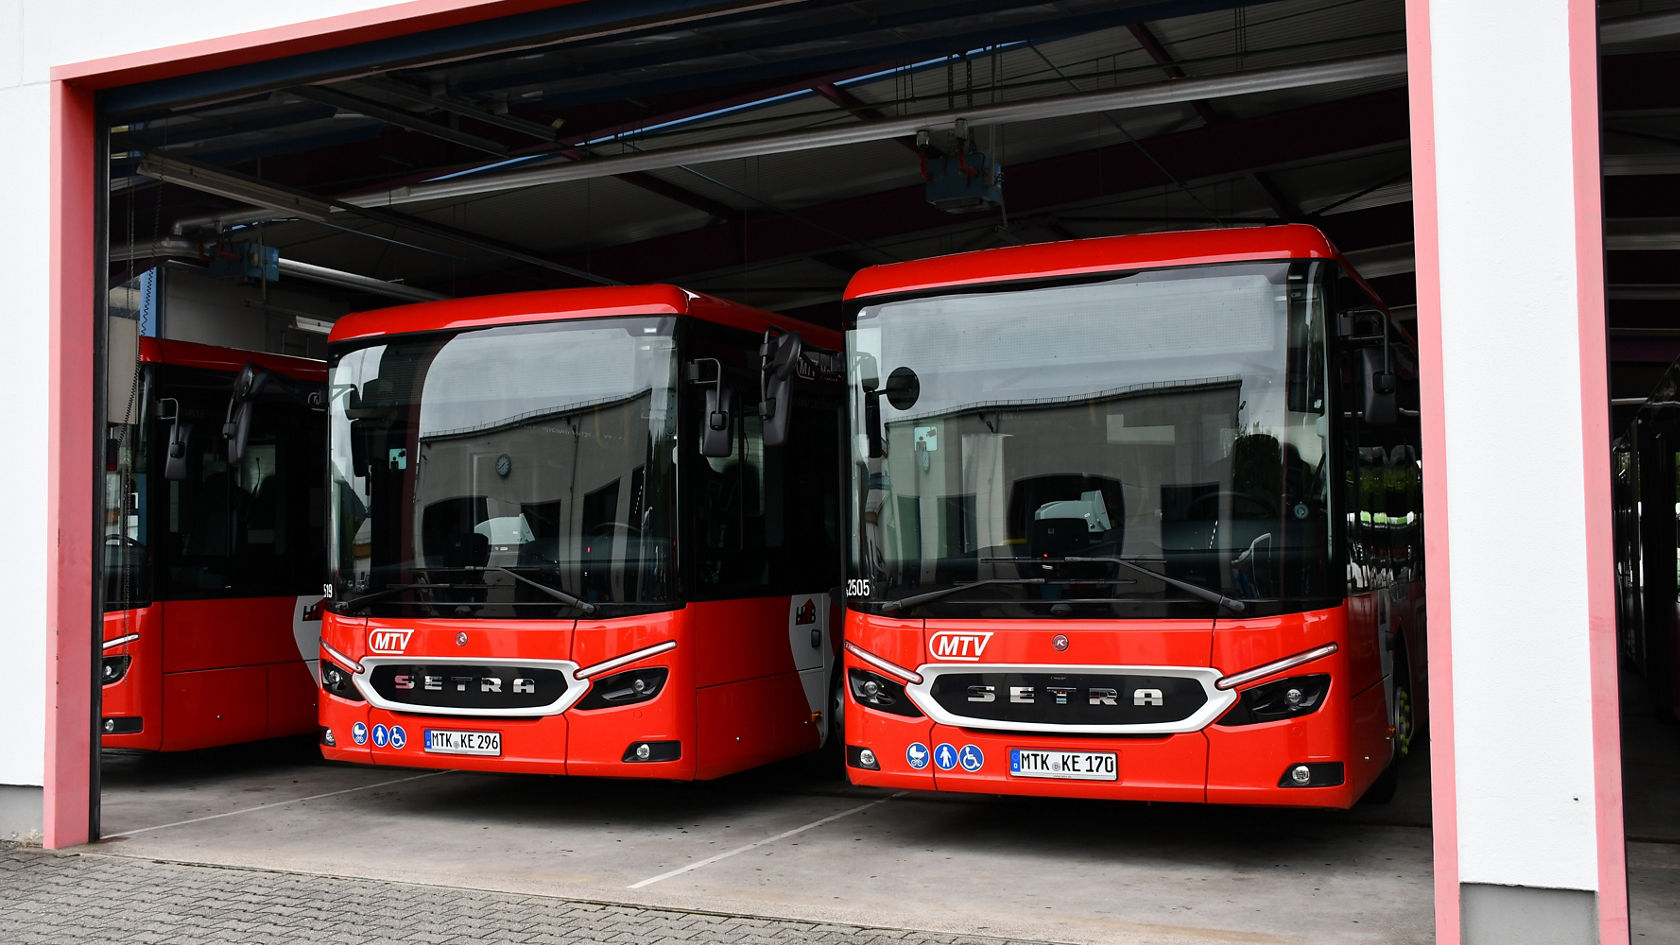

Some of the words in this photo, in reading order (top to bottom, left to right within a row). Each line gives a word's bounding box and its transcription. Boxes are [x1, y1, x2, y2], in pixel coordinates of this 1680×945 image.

[374, 630, 414, 650] MTV
[937, 633, 994, 656] MTV
[395, 675, 535, 694] SETRA
[967, 685, 1164, 706] SETRA
[432, 733, 453, 748] MTK
[460, 734, 475, 749] KE
[477, 735, 499, 750] 296
[1021, 753, 1050, 771] MTK
[1061, 755, 1081, 772] KE
[1085, 756, 1114, 773] 170
